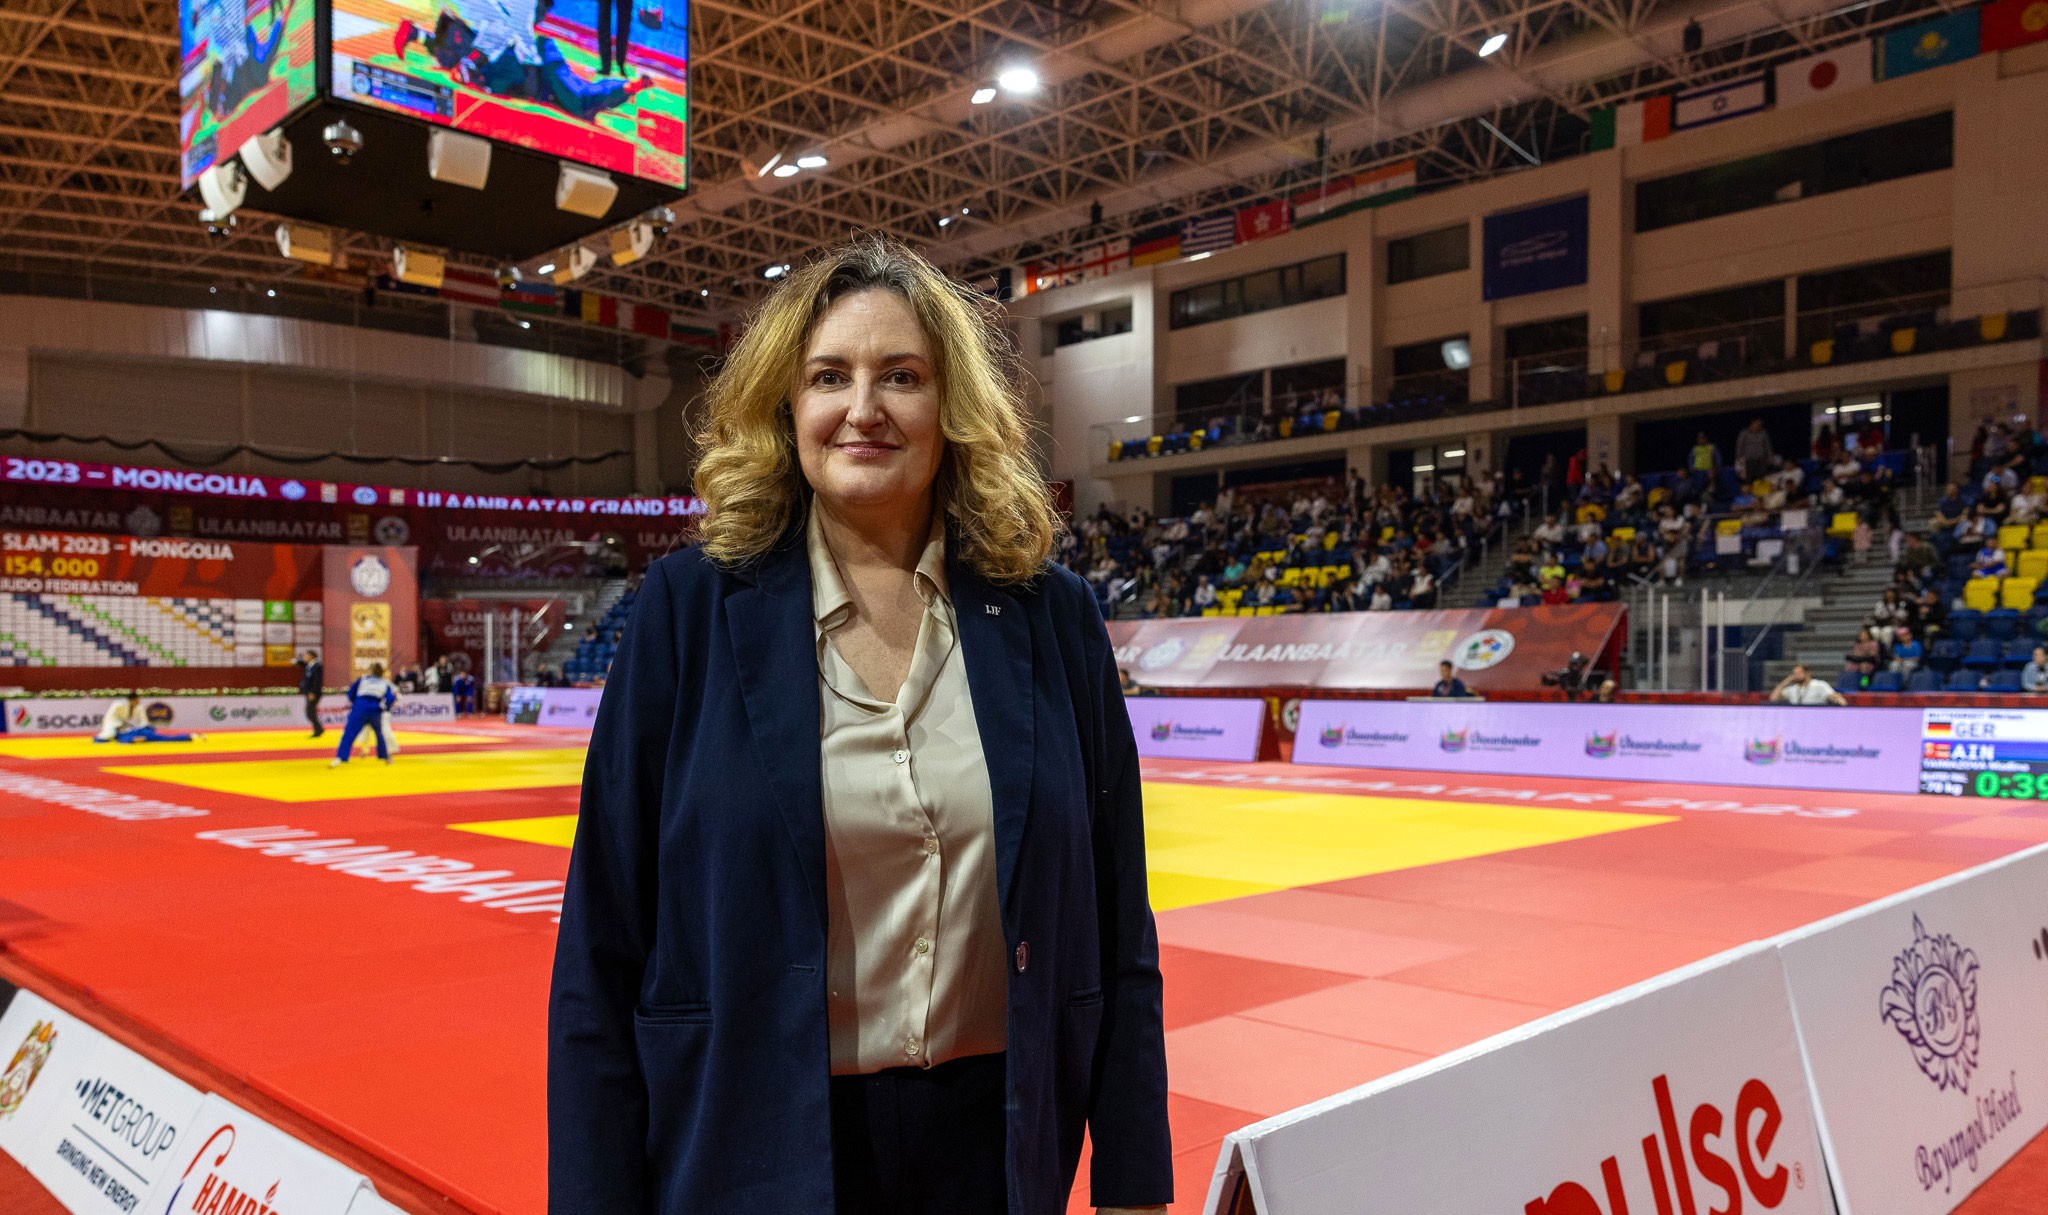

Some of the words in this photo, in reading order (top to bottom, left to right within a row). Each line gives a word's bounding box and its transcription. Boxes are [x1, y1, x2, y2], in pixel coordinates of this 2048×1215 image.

[7, 458, 81, 483] 2023
[112, 467, 268, 497] MONGOLIA
[589, 499, 665, 516] GRAND
[198, 516, 343, 538] ULAANBAATAR
[2, 532, 60, 553] SLAM
[62, 535, 111, 555] 2023
[130, 539, 235, 561] MONGOLIA
[44, 579, 140, 595] FEDERATION
[1219, 642, 1407, 662] ULAANBAATAR
[1956, 722, 1995, 738] GER
[1951, 743, 1996, 760] AIN
[82, 1077, 176, 1161] METGROUP
[1914, 1096, 1987, 1194] Bayangol
[1985, 1068, 2022, 1140] Hotel
[1524, 1073, 1789, 1215] ulse
[57, 1138, 92, 1176] BRINGING
[88, 1163, 111, 1190] NEW
[104, 1177, 140, 1214] ENERGY
